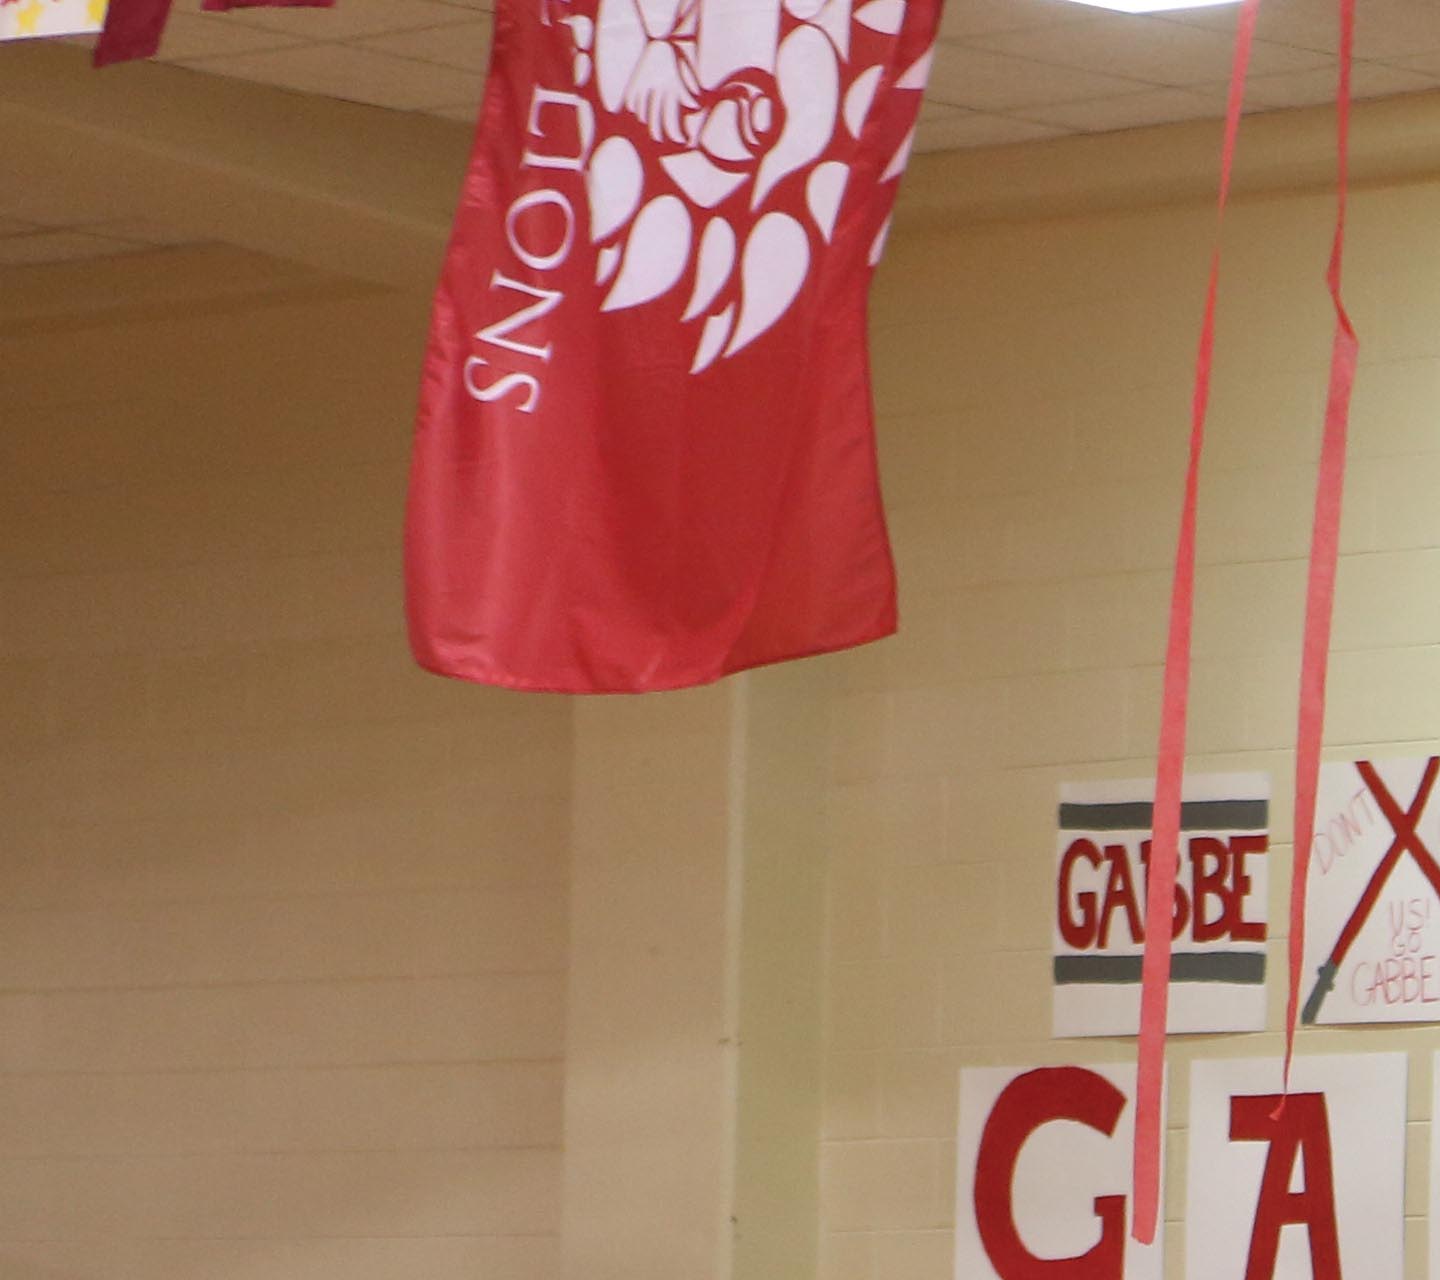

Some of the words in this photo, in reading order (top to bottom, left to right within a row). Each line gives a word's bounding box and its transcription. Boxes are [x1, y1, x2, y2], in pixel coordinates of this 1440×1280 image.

[463, 84, 598, 413] LIONS
[1058, 832, 1269, 950] GABBE
[1390, 932, 1424, 959] GO
